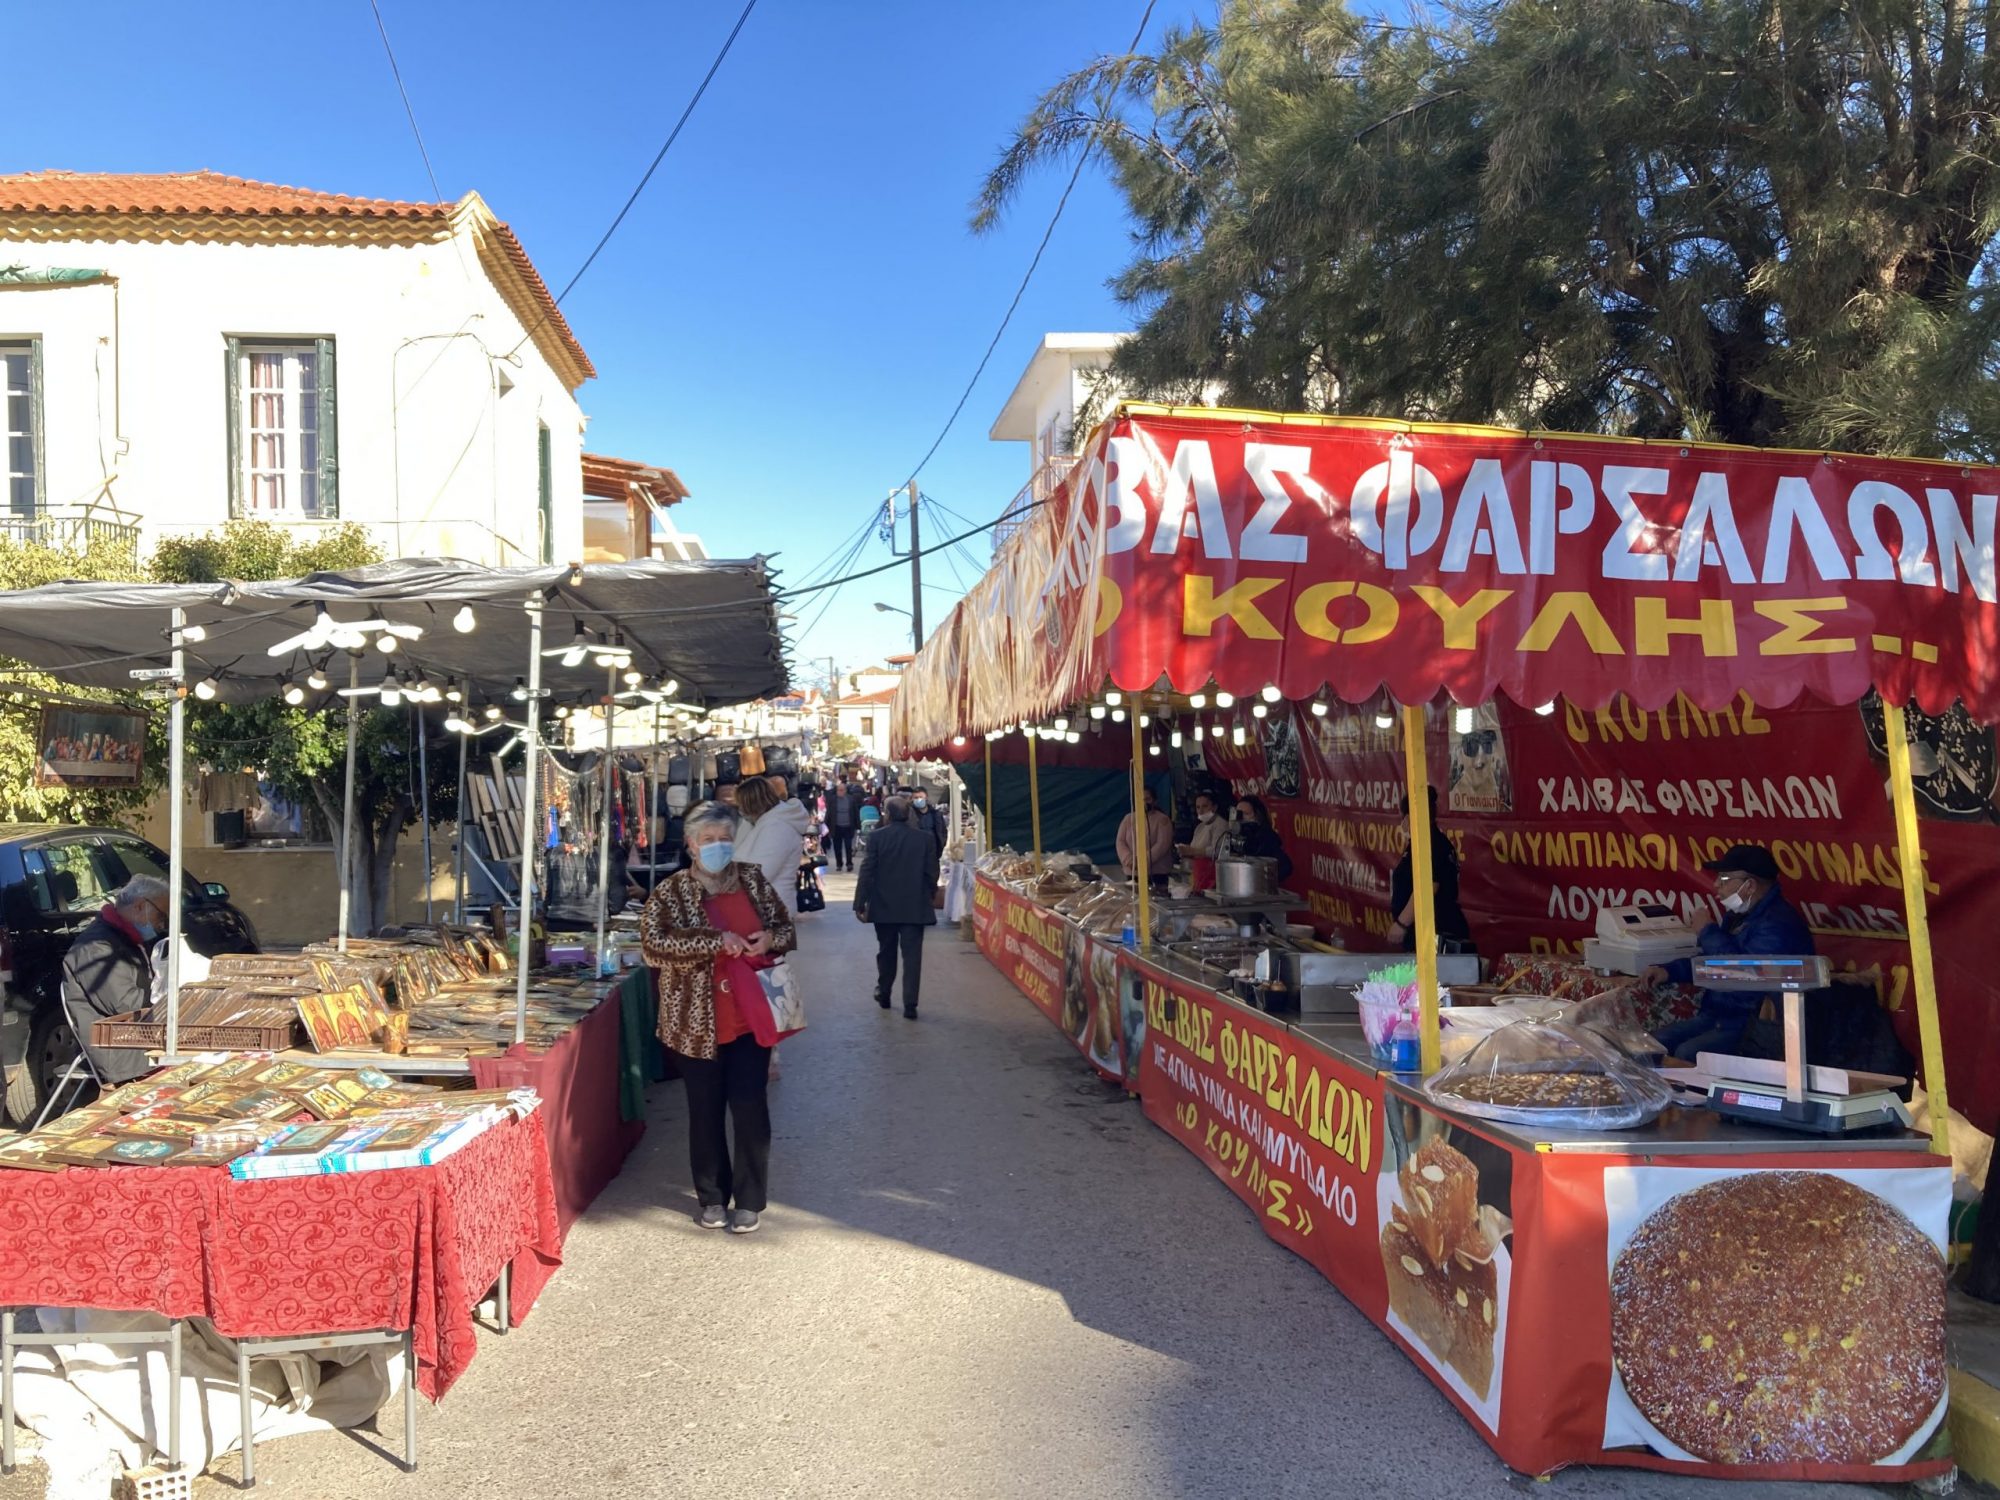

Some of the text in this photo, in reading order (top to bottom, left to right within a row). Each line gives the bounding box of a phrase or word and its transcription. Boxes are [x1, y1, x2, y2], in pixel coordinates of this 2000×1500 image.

[1349, 449, 1997, 603] ΦΑΡΣΑΛΩΝ
[1335, 714, 1405, 755] ΚΟΥΛΗ
[1598, 688, 1771, 741] ΚΟΥΛΗΣ
[1355, 779, 1405, 809] ΦΑΡΣΑ
[1537, 775, 1842, 819] ΧΑΛΒΑΣ ΦΑΡΣΑΛΩΝ
[1311, 853, 1377, 893] ΛΟΥΚΟΥΜΙΑ
[1490, 830, 1941, 896] ΟΛΥΜΠΙΑΚΟΙ ΛΟΟΥΜΑΔΣ
[1548, 885, 1724, 928] ΛΟΥΚΟΥΜΙ
[1168, 1053, 1200, 1096] ΑΓΝΑ
[1220, 1019, 1373, 1174] ΦΑΡΣΑΛΩΝ
